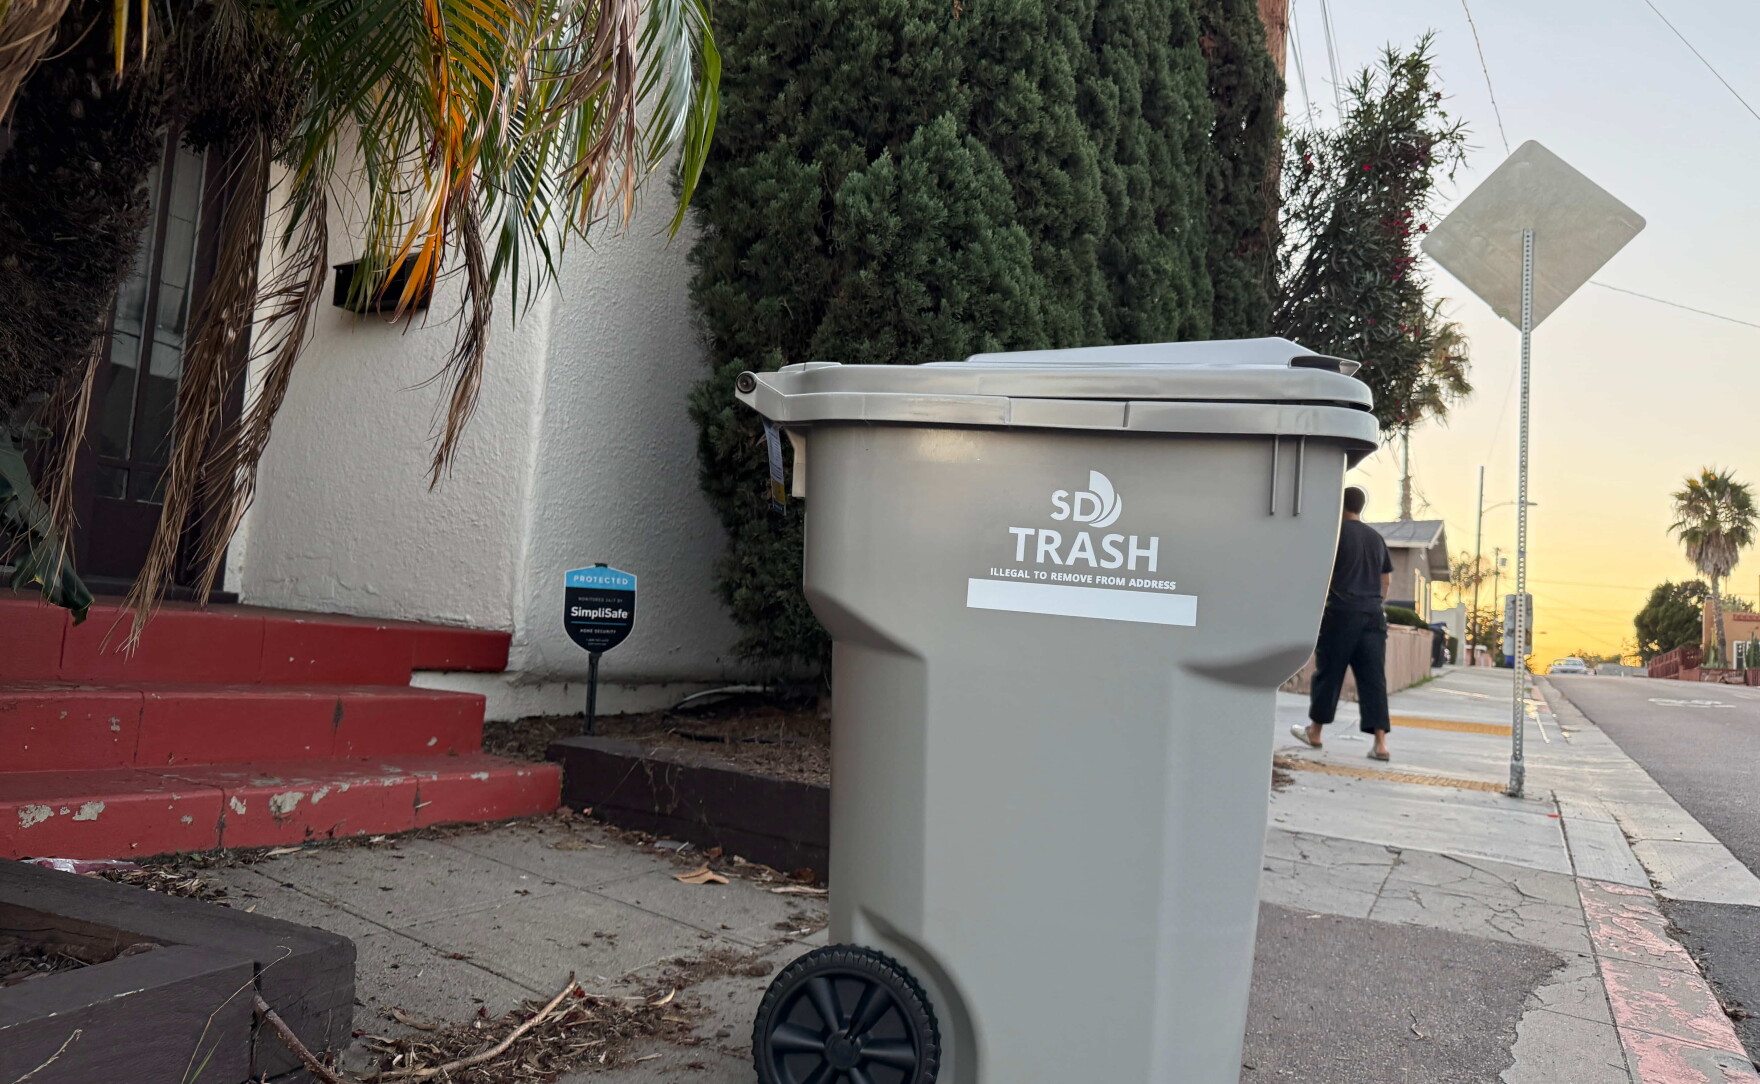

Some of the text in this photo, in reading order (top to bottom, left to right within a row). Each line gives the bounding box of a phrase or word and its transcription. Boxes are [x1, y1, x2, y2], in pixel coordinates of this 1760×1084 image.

[1050, 489, 1103, 522] SD
[1008, 526, 1159, 572] TRASH
[573, 575, 629, 585] PROTECTED
[990, 567, 1177, 591] ILLEGAL TO REMOVE FROM ADDRESS
[570, 606, 628, 620] SimpliSafe
